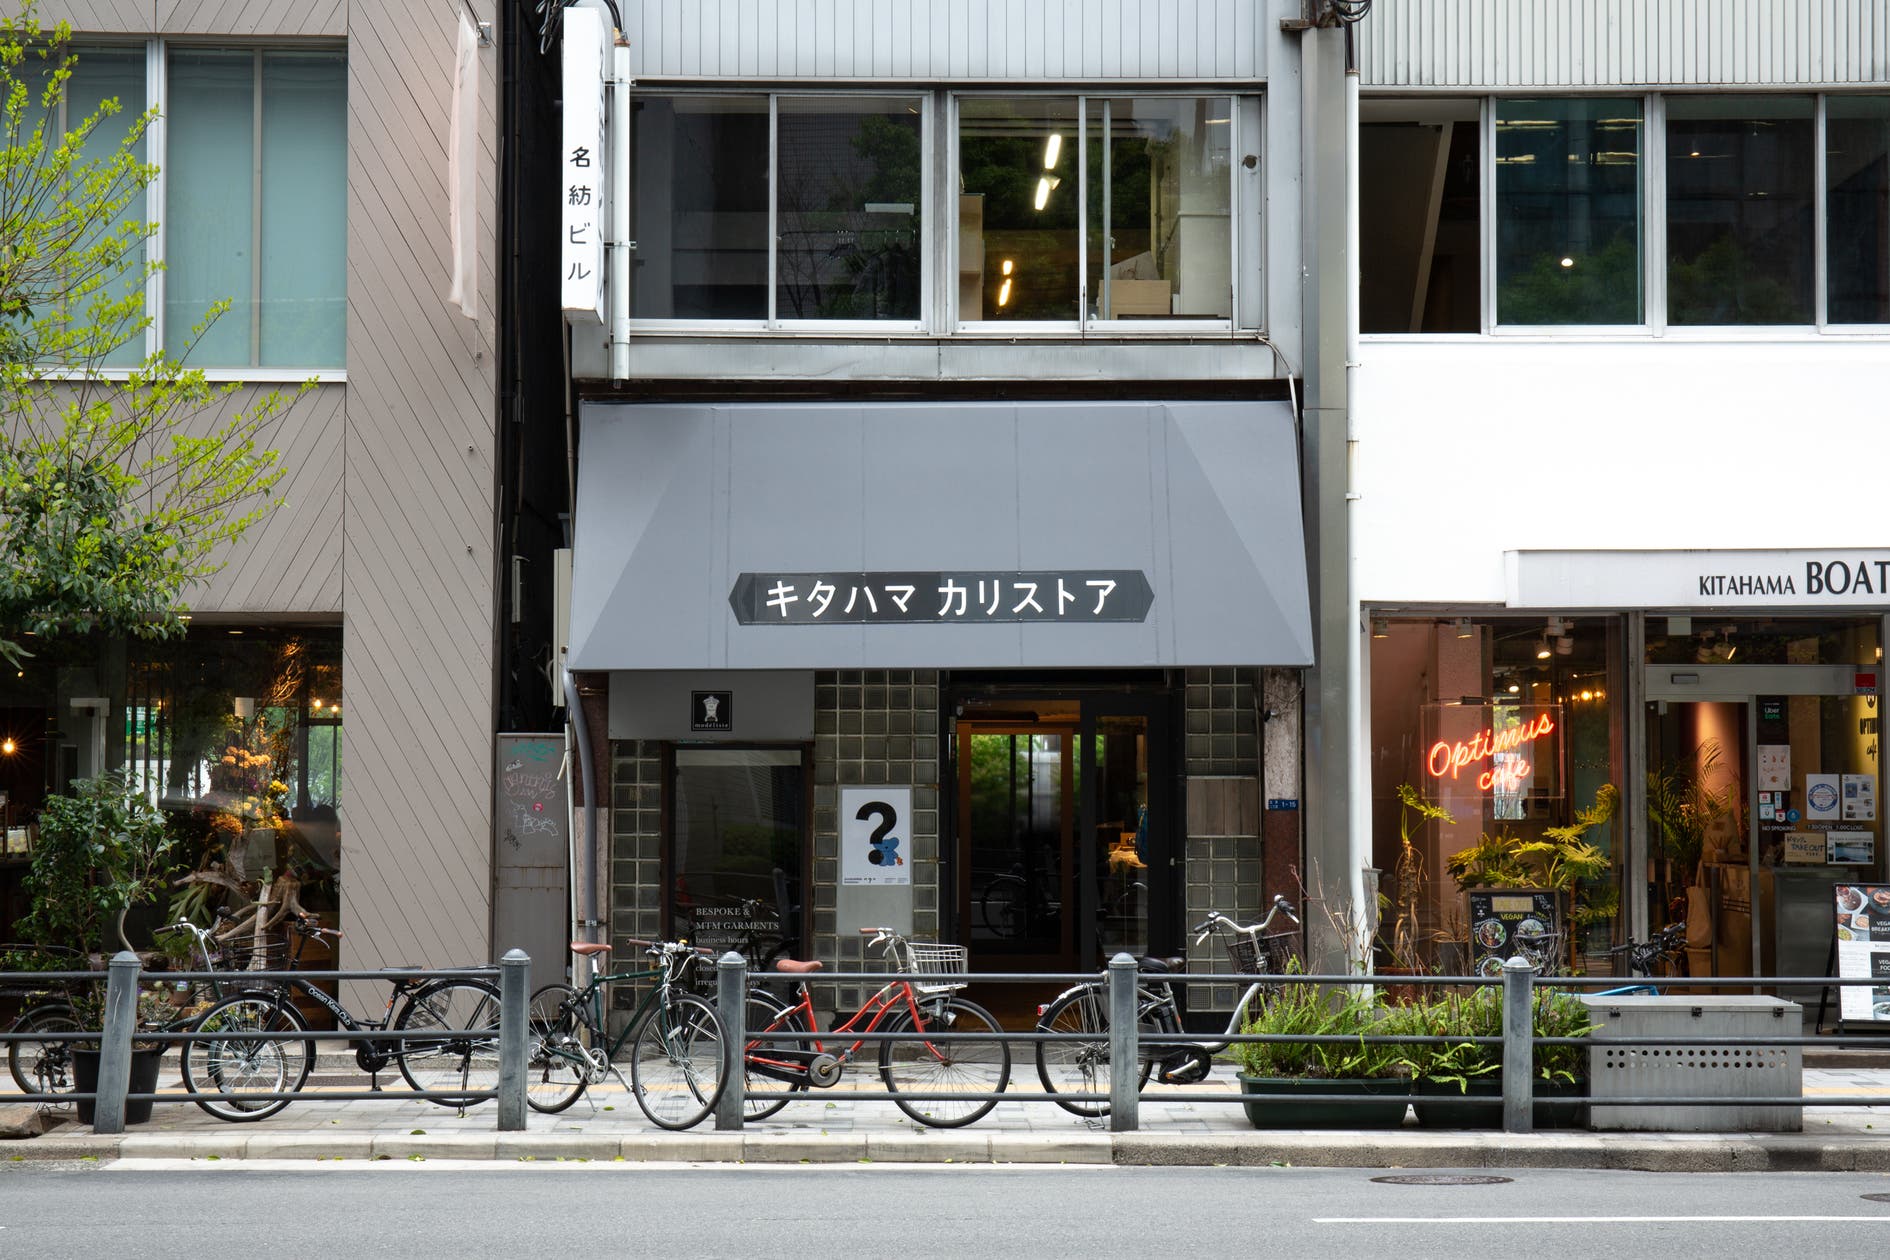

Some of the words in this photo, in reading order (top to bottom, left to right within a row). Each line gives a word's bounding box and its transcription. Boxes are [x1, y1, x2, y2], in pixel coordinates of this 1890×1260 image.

[567, 146, 592, 281] 名紡ビル
[1699, 575, 1796, 595] KITAHAMA
[1806, 560, 1890, 595] BOAT
[766, 580, 916, 618] キタハマ
[938, 578, 1117, 617] カリストア
[1429, 713, 1554, 780] Optimus
[1480, 752, 1530, 790] cafe
[696, 908, 741, 916] BESPOKE
[743, 908, 750, 916] &
[696, 922, 720, 930] MTM
[724, 922, 779, 930] GARMENTS
[695, 936, 726, 944] business
[728, 936, 749, 944] hours
[308, 987, 328, 1004] Ocean
[339, 1012, 351, 1026] Club
